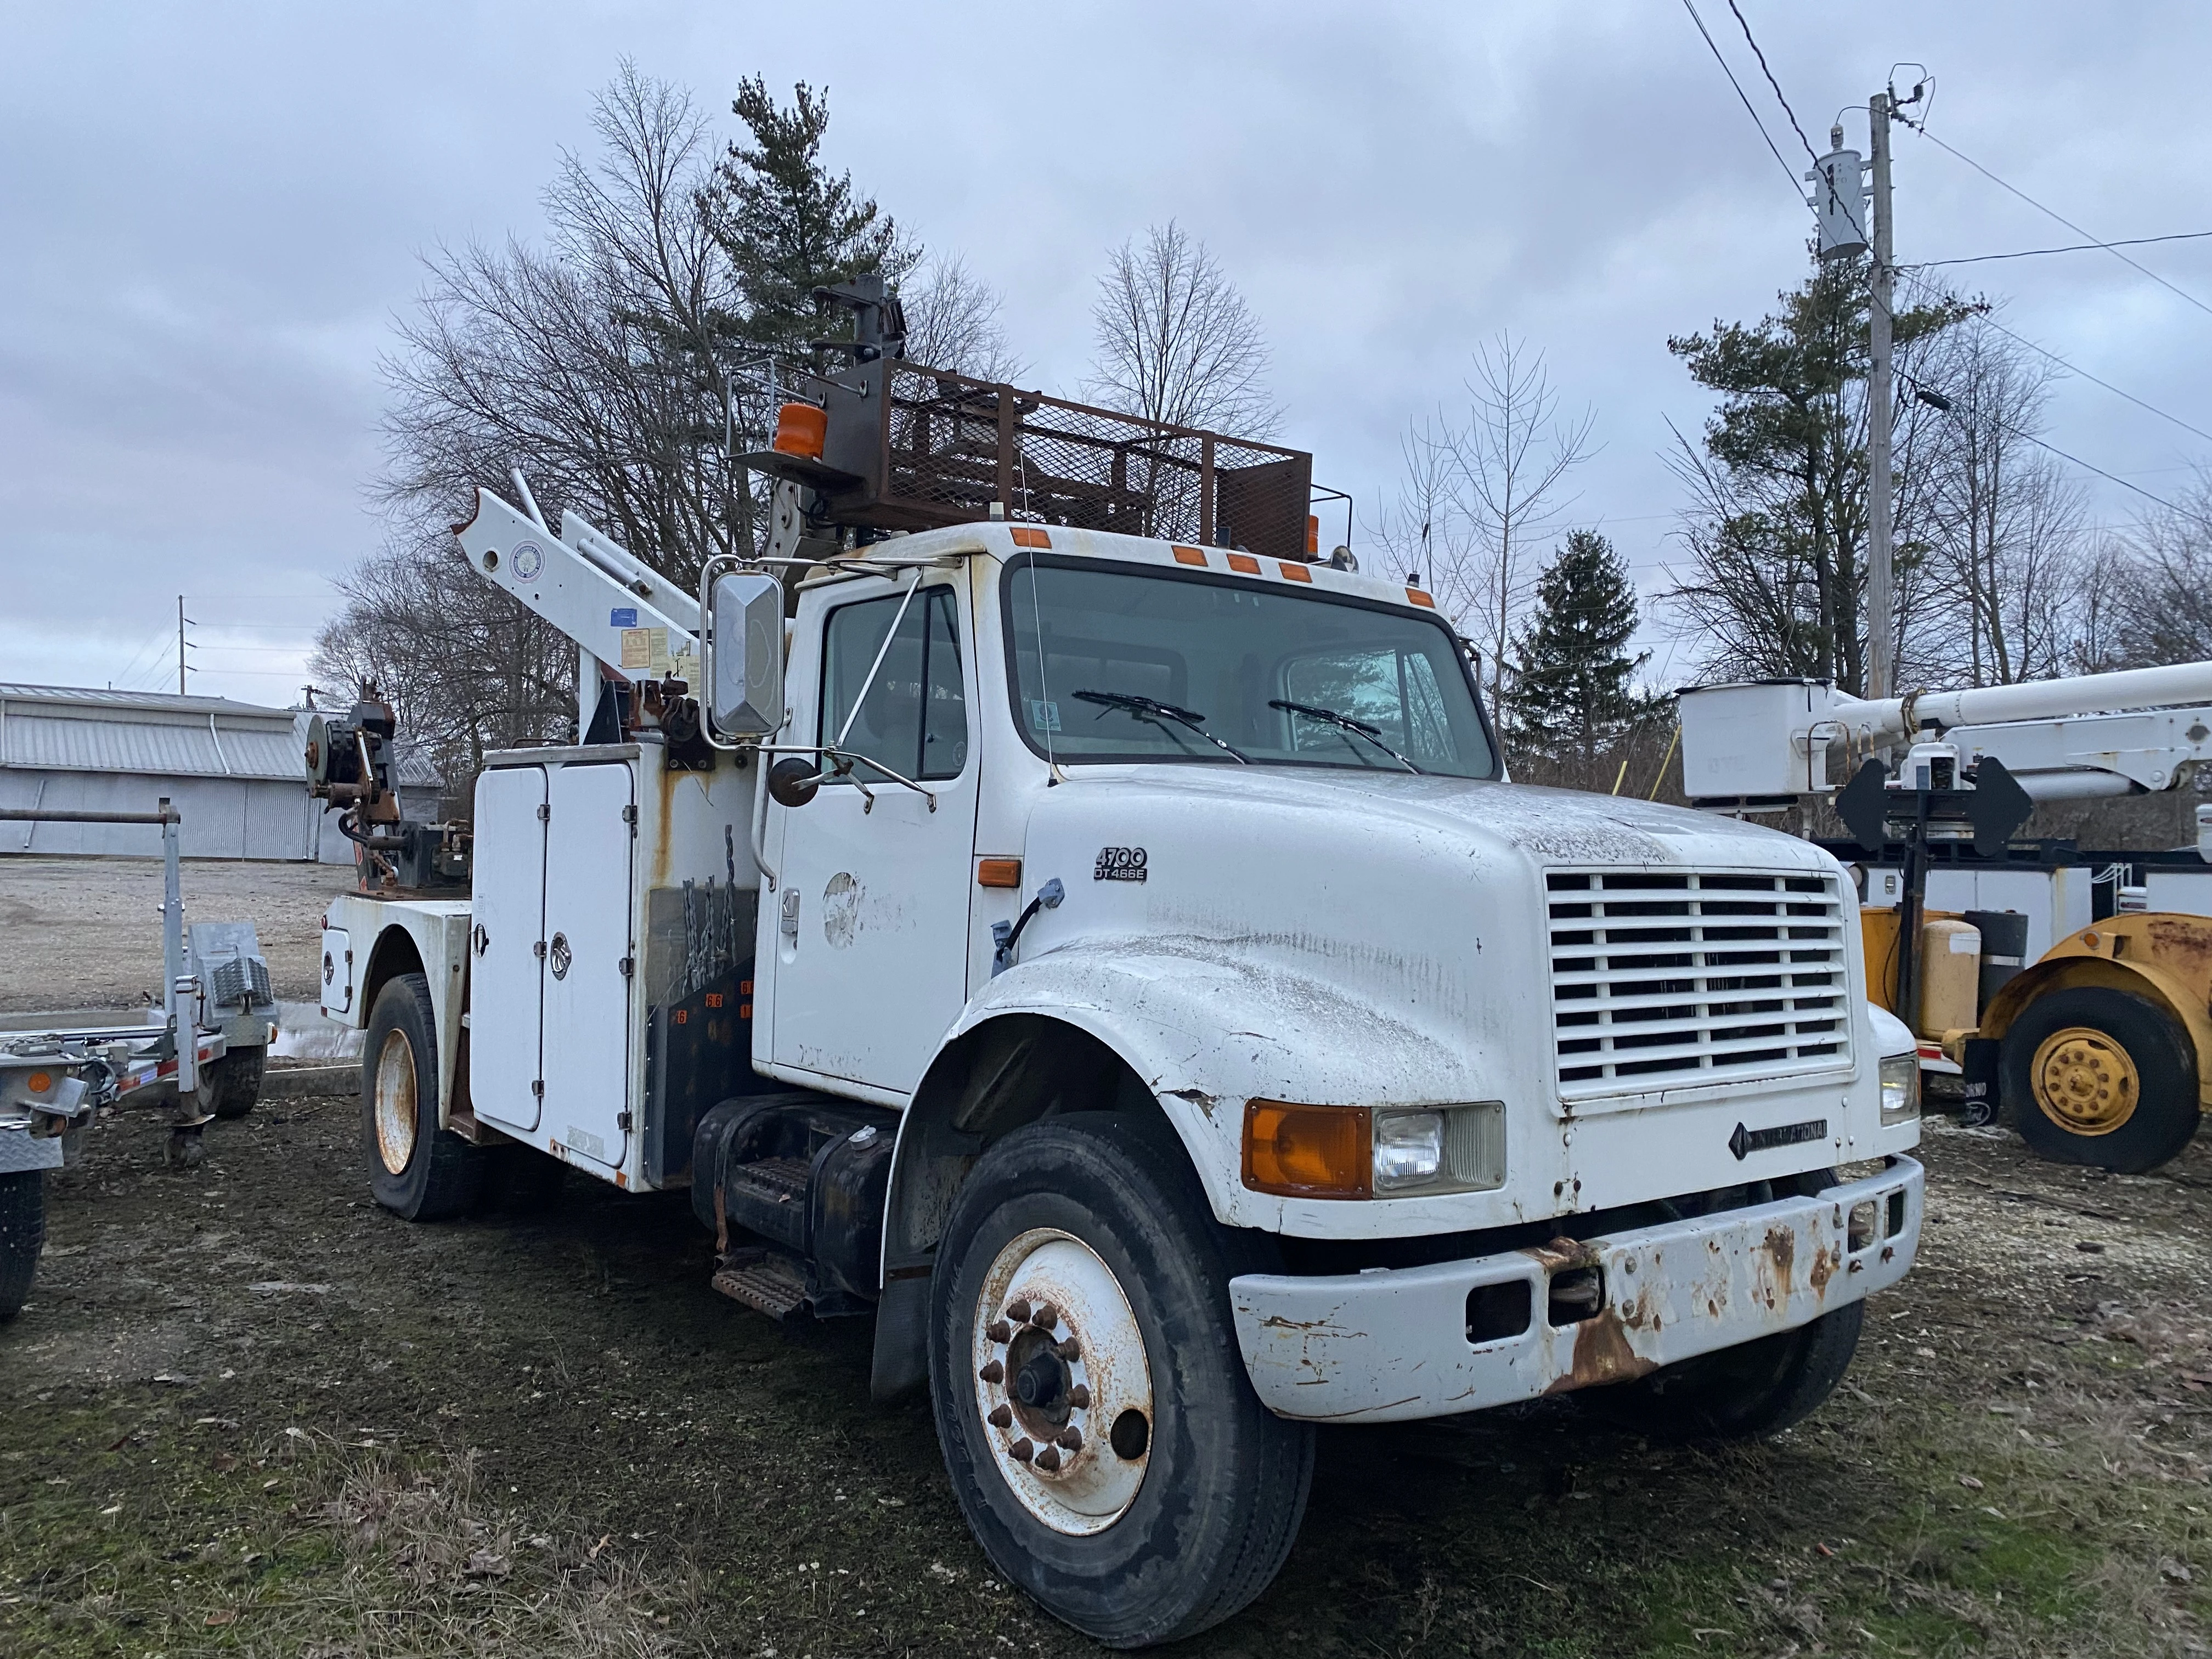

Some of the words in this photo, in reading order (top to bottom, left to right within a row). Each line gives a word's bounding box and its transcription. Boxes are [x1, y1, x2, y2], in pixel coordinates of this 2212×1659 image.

[1096, 848, 1146, 867] 4700
[1094, 868, 1110, 879] DT
[1111, 868, 1144, 879] 466E
[707, 995, 721, 1007] 66
[1754, 1121, 1827, 1148] ATIONAL
